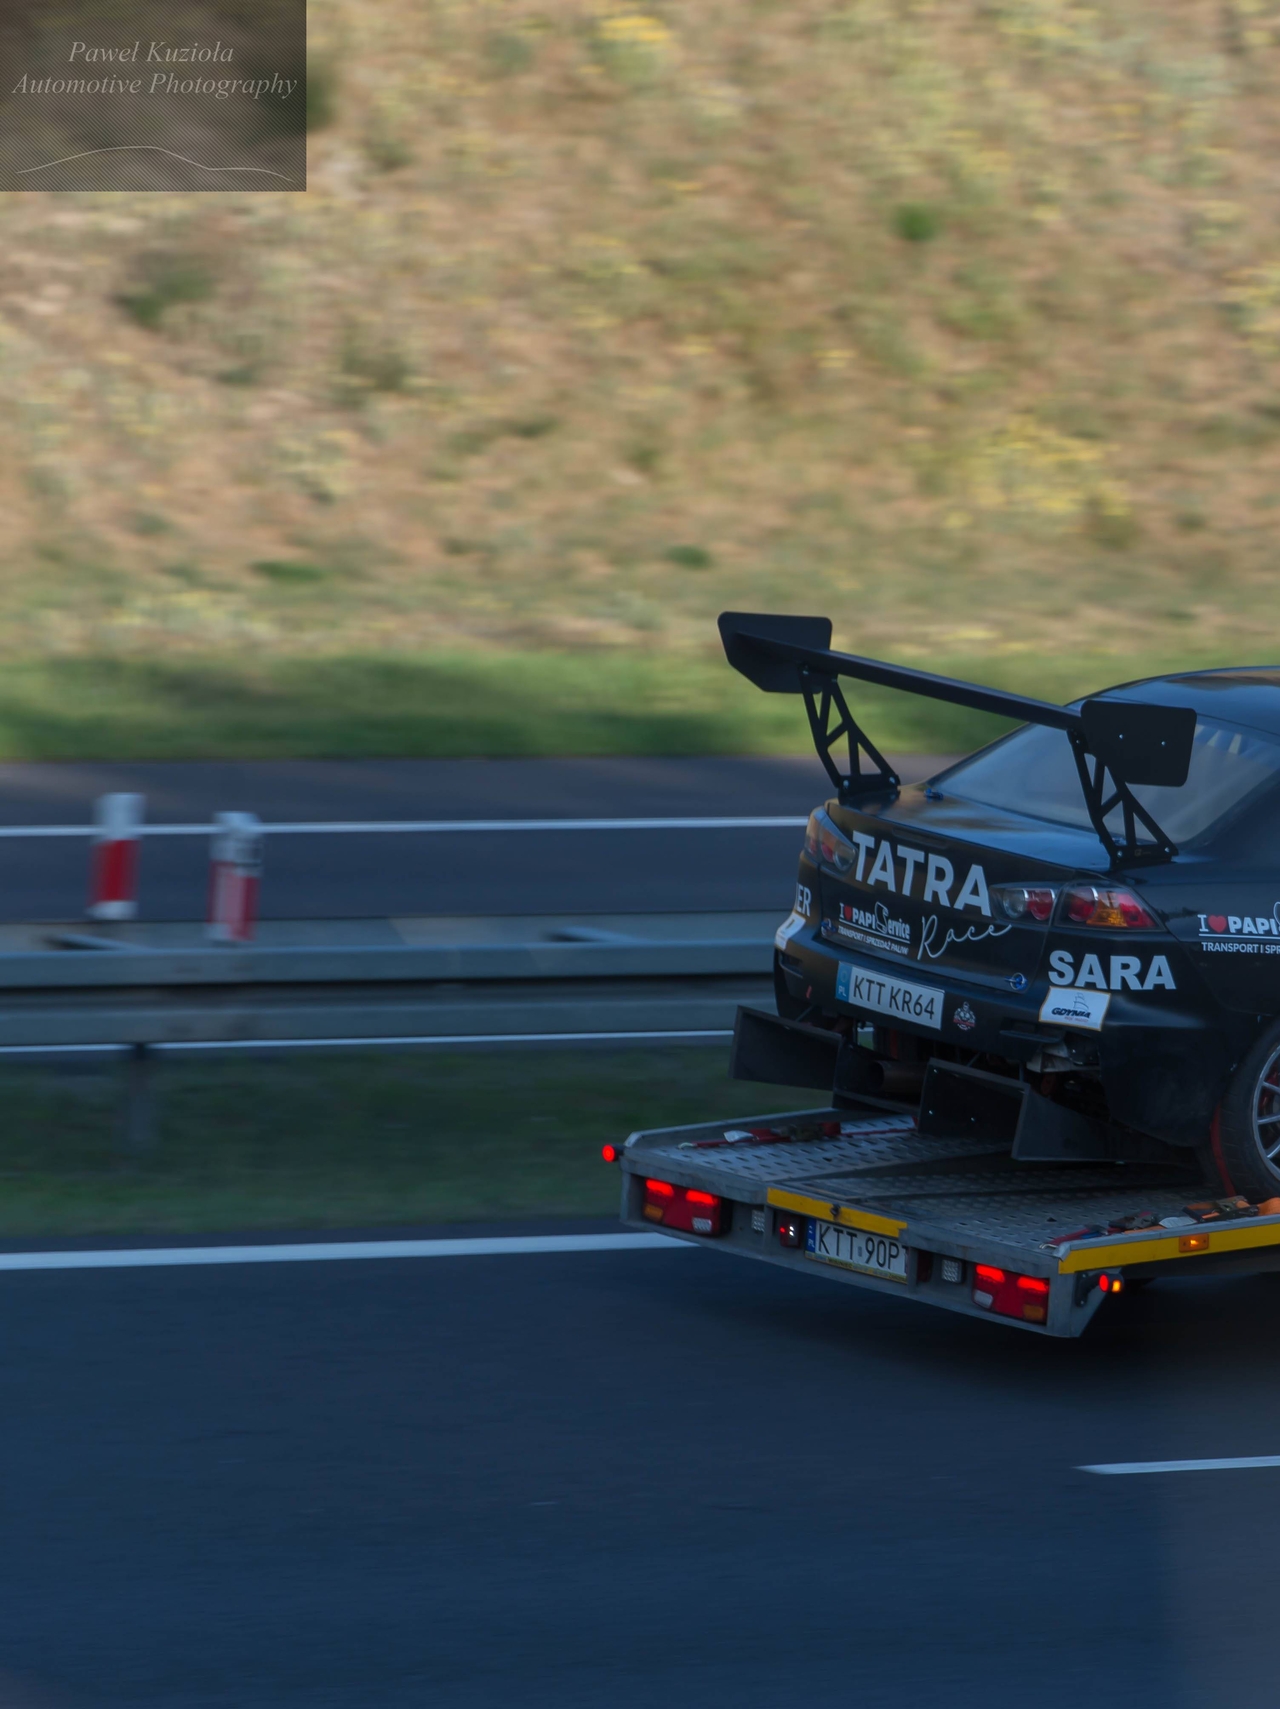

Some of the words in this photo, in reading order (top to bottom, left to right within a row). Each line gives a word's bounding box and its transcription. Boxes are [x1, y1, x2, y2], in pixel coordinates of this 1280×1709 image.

[852, 829, 992, 917] TATRA
[916, 914, 1013, 961] Race
[1201, 941, 1260, 954] TRANSPORT
[1048, 949, 1177, 990] SARA
[853, 974, 886, 1006] KTT
[889, 985, 935, 1021] KR64
[818, 1223, 858, 1261] KTT
